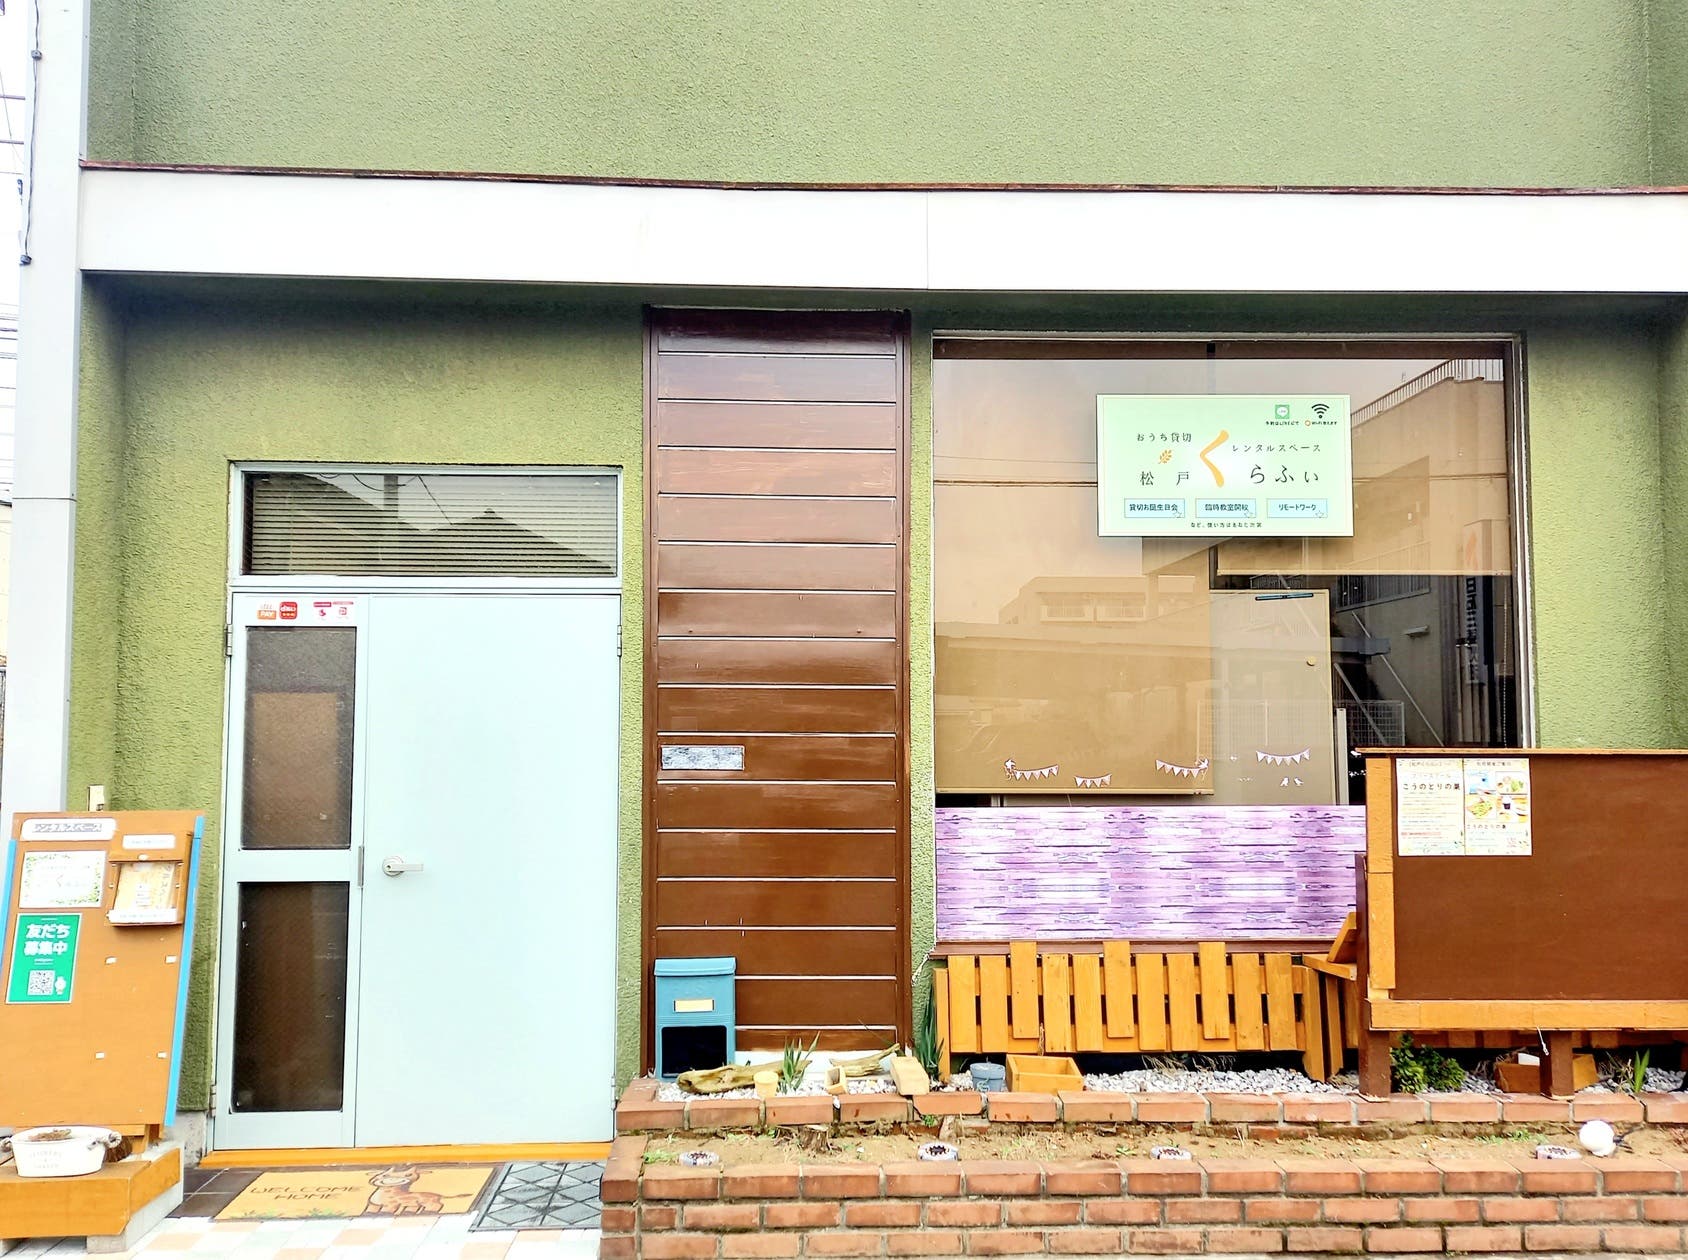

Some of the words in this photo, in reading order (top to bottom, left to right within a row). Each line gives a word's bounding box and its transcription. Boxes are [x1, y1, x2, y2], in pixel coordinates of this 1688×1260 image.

[1136, 432, 1192, 443] おうち貸切
[1232, 443, 1322, 453] レンタルスペース
[1278, 503, 1317, 512] リモートワーク
[26, 923, 71, 939] 友だち
[23, 940, 69, 956] 募集中
[250, 1186, 361, 1194] WELCOME
